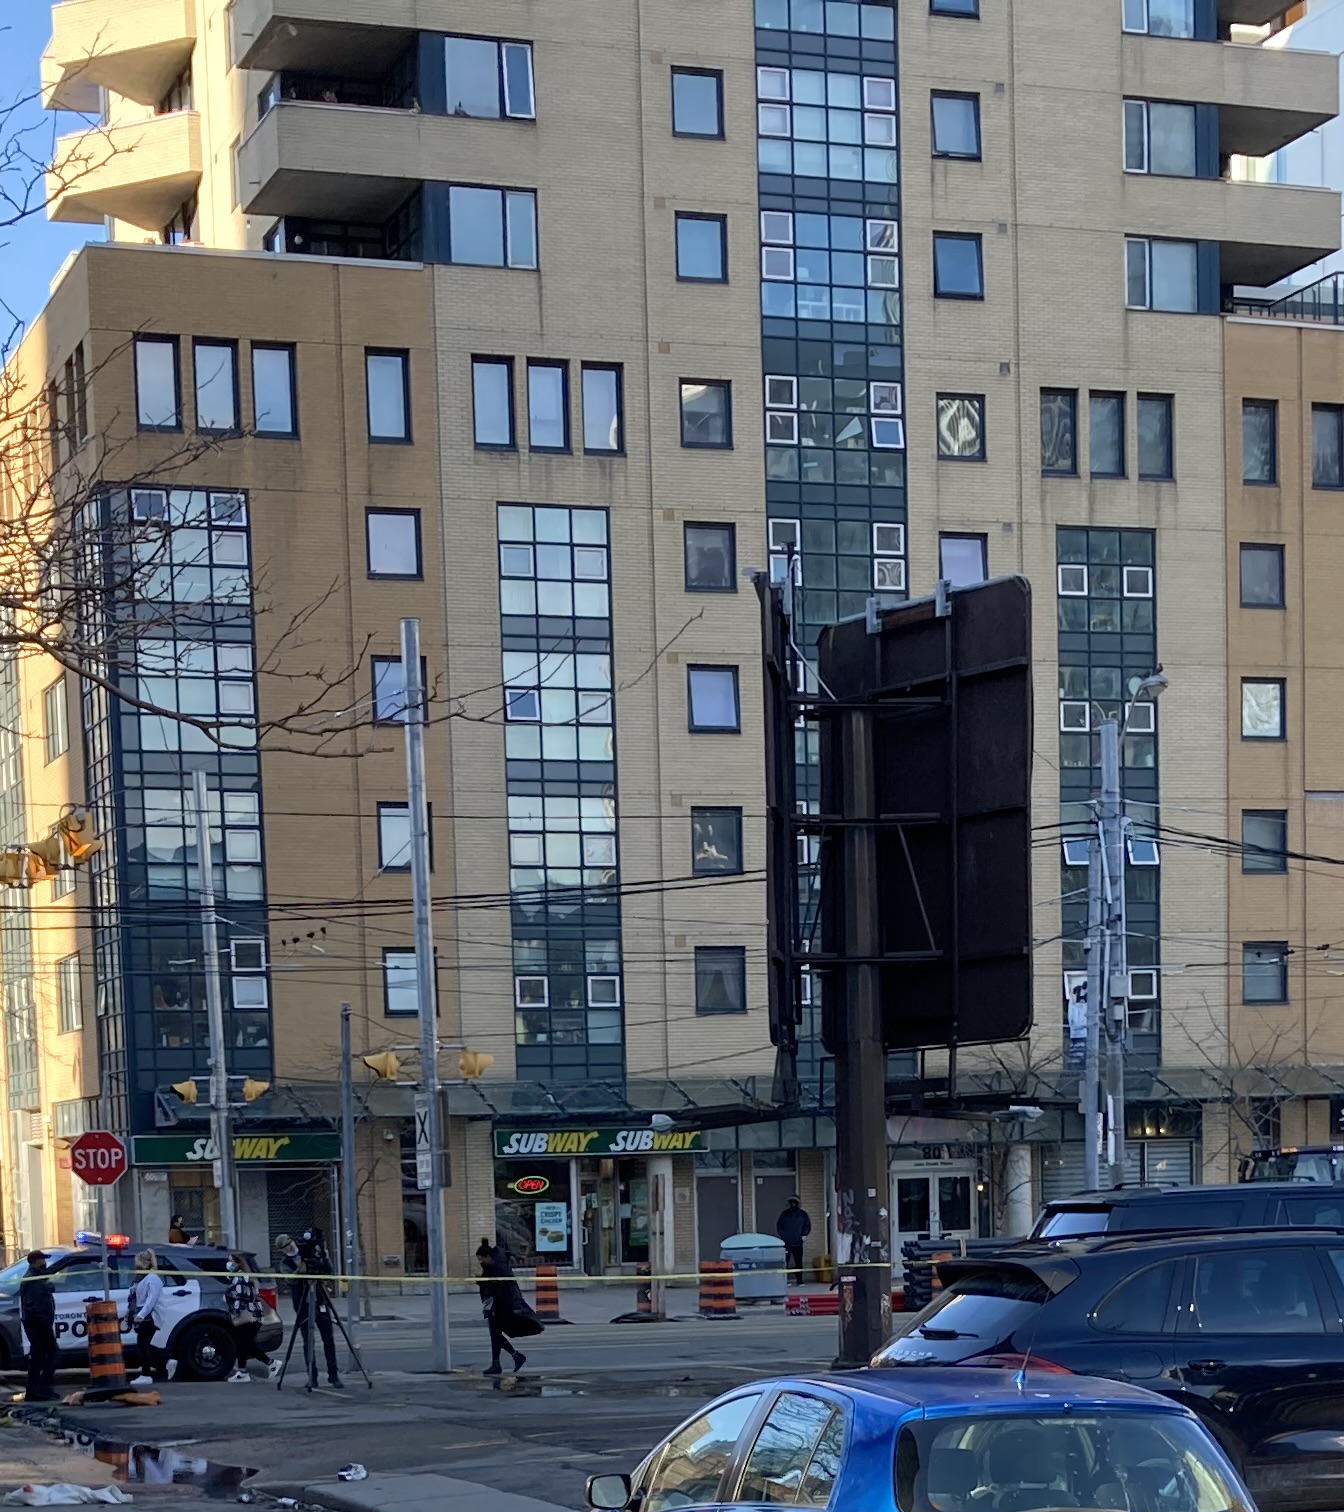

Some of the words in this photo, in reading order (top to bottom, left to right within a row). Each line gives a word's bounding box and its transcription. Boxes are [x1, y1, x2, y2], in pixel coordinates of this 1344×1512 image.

[186, 1136, 291, 1160] SUWAY
[502, 1131, 599, 1154] SUBWAY
[609, 1130, 701, 1151] SUBWAY
[74, 1148, 123, 1170] STOP
[518, 1178, 545, 1190] OPEN
